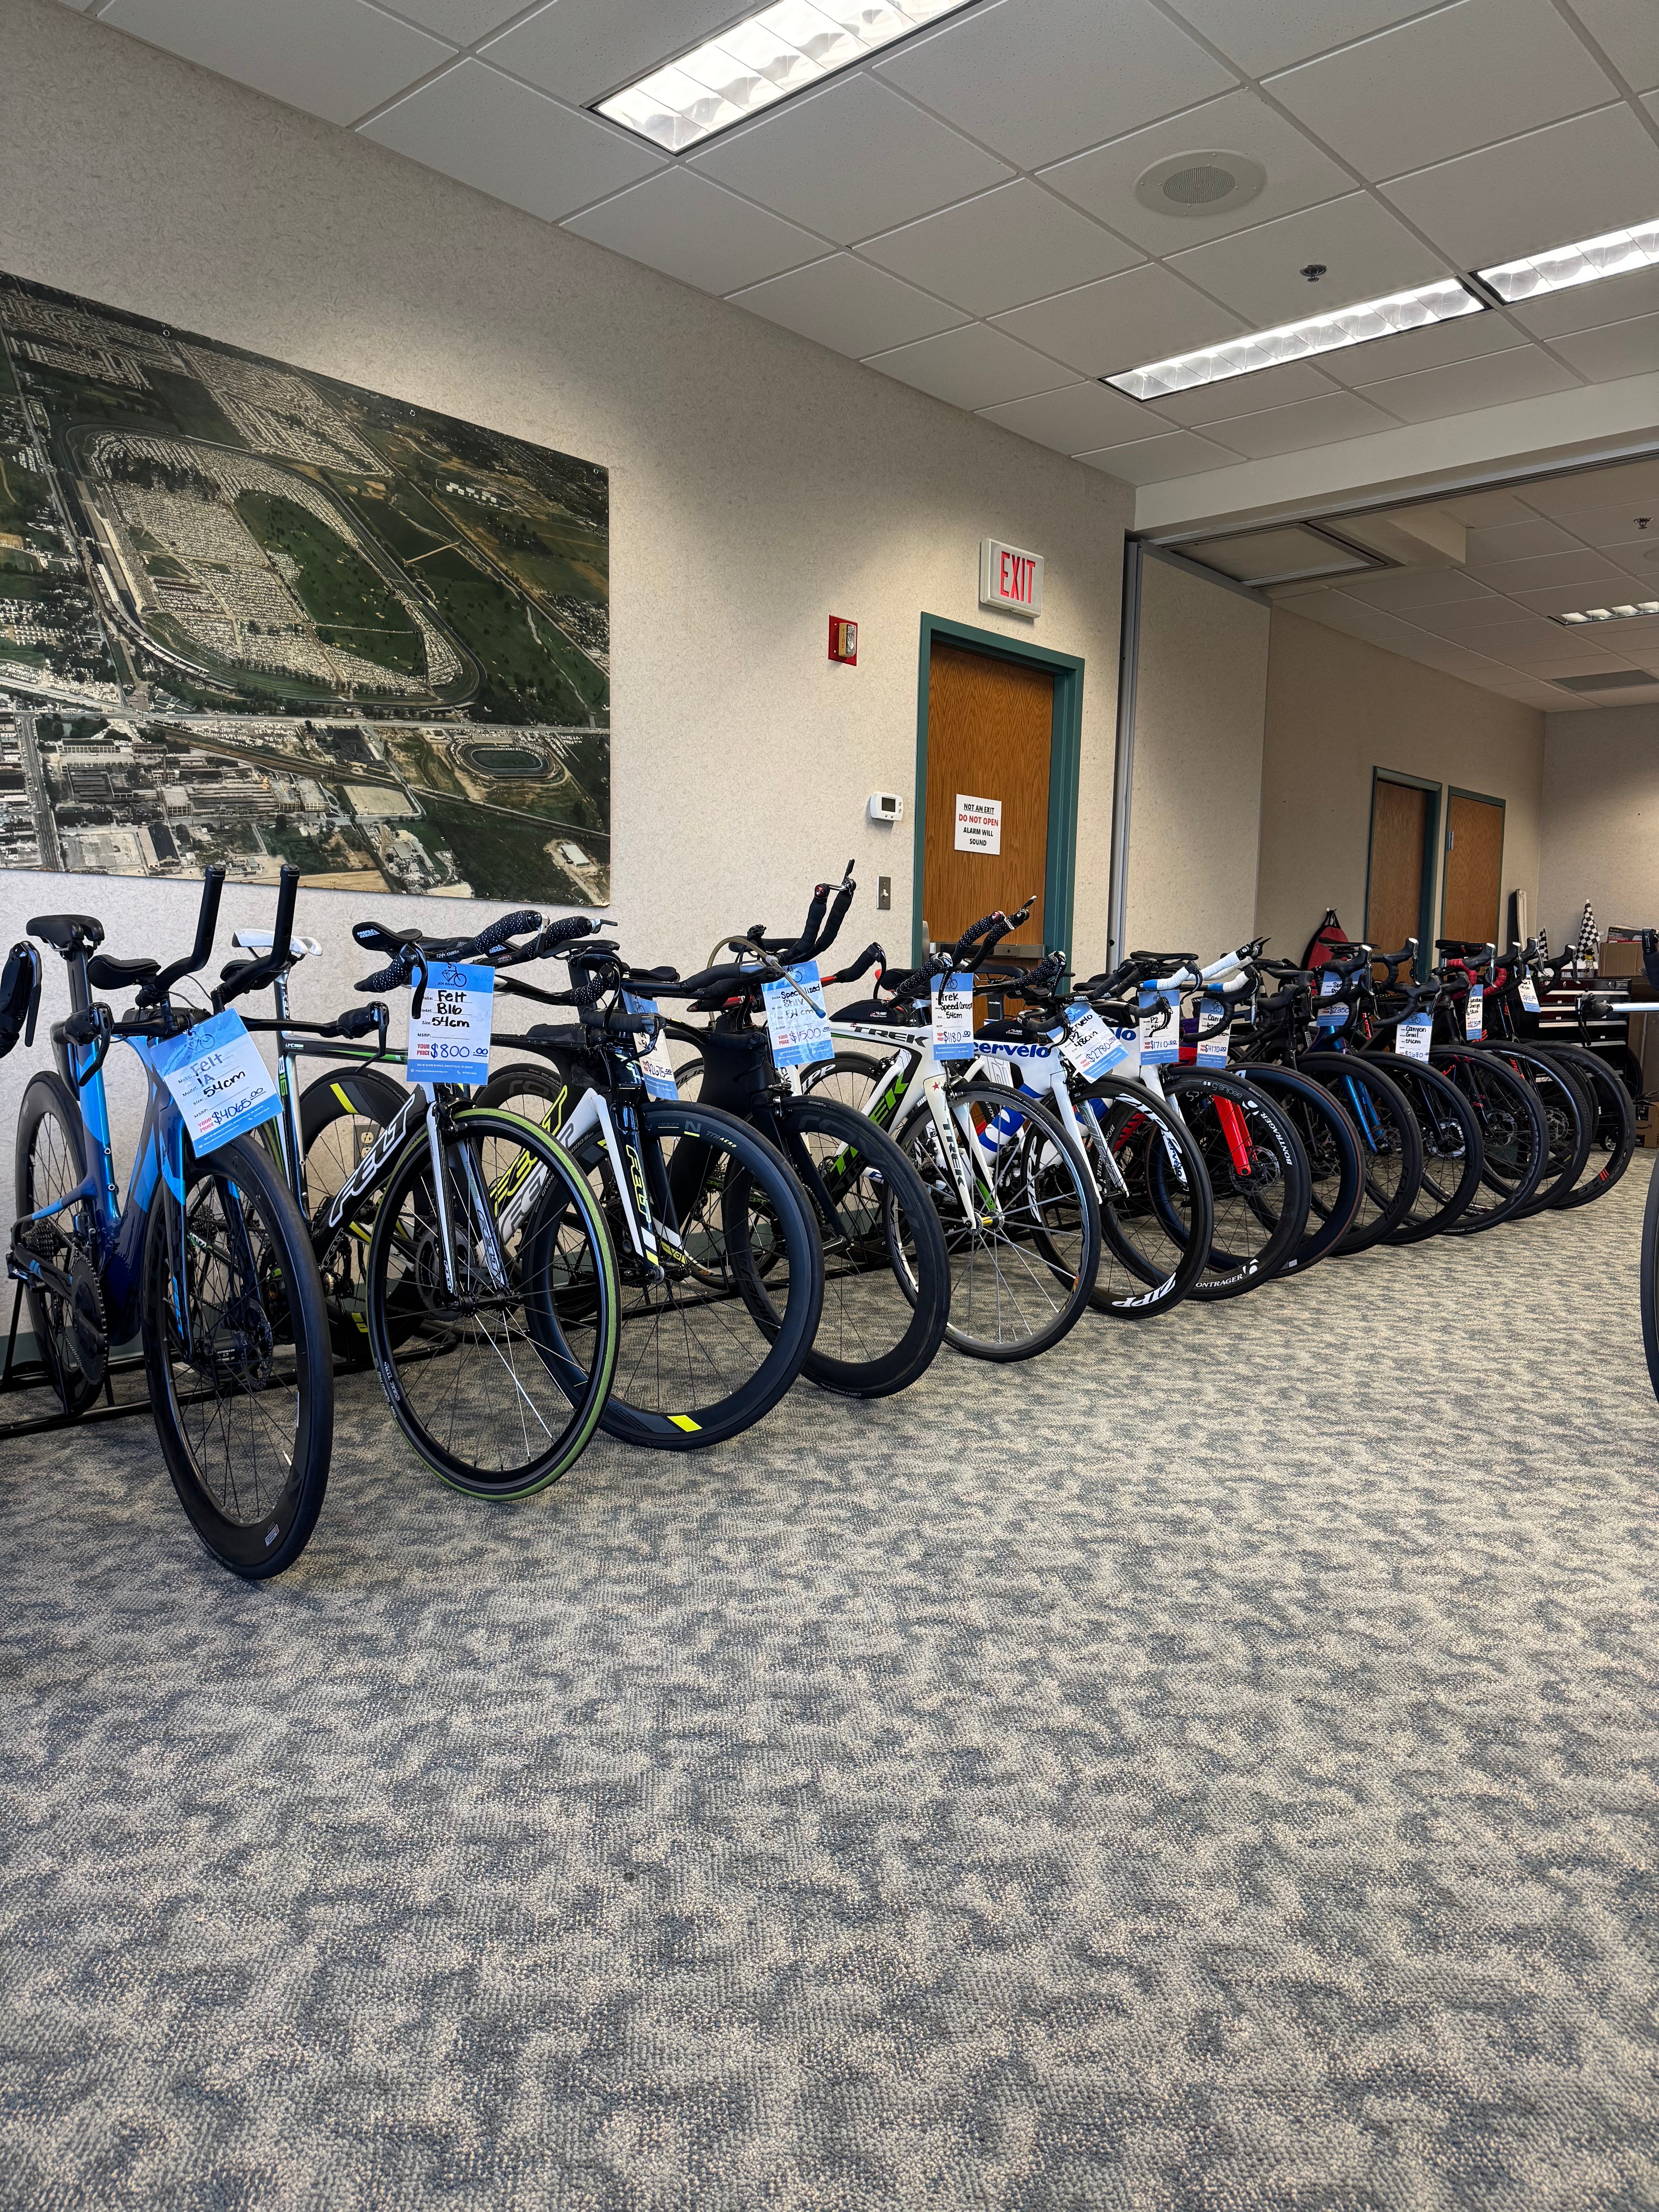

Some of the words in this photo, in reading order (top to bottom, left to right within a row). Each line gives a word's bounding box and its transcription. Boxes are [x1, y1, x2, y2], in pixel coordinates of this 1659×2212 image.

[1000, 551, 1036, 604] EXIT
[969, 815, 982, 824] NOT
[983, 817, 998, 826] OPEN
[963, 827, 981, 835] ALARM
[438, 990, 467, 1002] Felt
[941, 993, 959, 1001] Trek
[940, 1001, 959, 1012] Speed
[432, 1017, 470, 1028] 54cm
[853, 1026, 929, 1048] TREK
[1074, 1031, 1098, 1047] 48cm
[178, 1075, 192, 1084] Make:
[190, 1054, 223, 1077] Felt
[182, 1087, 199, 1097] Model:
[193, 1097, 204, 1106] Size:
[203, 1071, 246, 1098] 54cm
[1219, 1085, 1242, 1098] aeolus
[1010, 1093, 1022, 1101] PRIX
[194, 1108, 209, 1118] MSRP:
[198, 1117, 212, 1127] YOUR
[200, 1123, 214, 1133] PRICE
[1115, 1093, 1182, 1154] ZIPP
[1260, 1111, 1293, 1165] BONTRAGER
[942, 1118, 965, 1187] TREK
[329, 1093, 416, 1227] FELT
[626, 1144, 652, 1225] FELT
[322, 1227, 345, 1268] FELT
[1195, 1274, 1244, 1288] ONTRAGER
[1111, 1272, 1176, 1307] ZIPP
